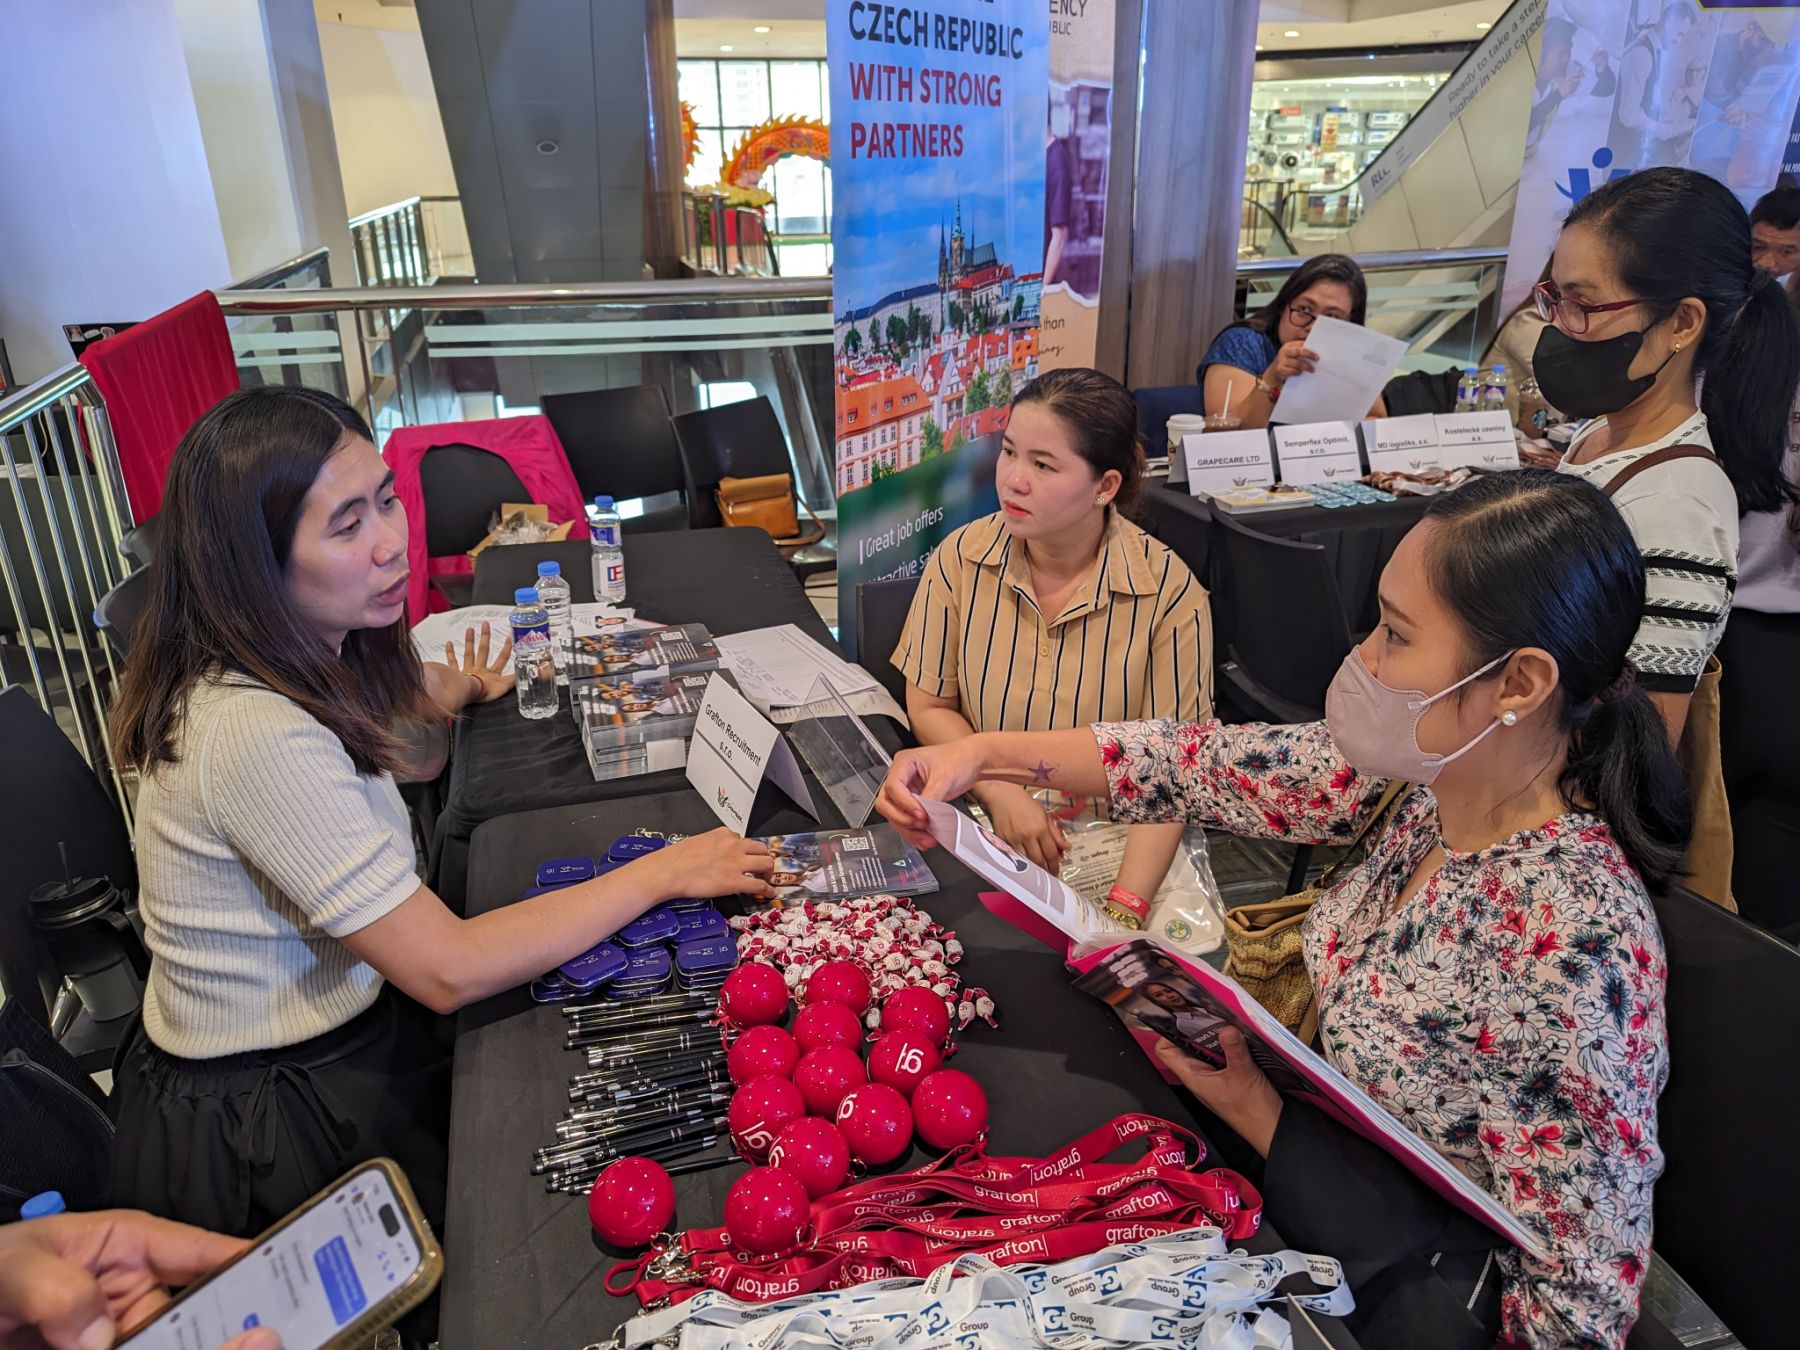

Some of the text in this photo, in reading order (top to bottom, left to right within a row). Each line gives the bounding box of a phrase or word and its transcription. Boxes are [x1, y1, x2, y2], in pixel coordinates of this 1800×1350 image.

[849, 0, 1024, 60] CZECH REPUBLIC
[1480, 74, 1490, 88] in
[1514, 10, 1546, 50] career
[1448, 69, 1476, 103] Ready
[1477, 57, 1488, 71] to
[1488, 31, 1510, 58] take
[1512, 22, 1518, 33] a
[849, 62, 1002, 107] WITH STRONG
[851, 122, 964, 159] PARTNERS
[1284, 439, 1321, 448] Semperflex
[1197, 455, 1261, 467] GRAPECARE LTD
[865, 506, 944, 559] Great job offers
[705, 703, 726, 731] Grafton
[725, 724, 762, 768] Recruitment
[719, 741, 733, 761] s.r.o.
[1034, 1147, 1081, 1182] grafton
[1105, 1190, 1168, 1220] grafton
[1000, 1212, 1062, 1230] grafton
[931, 1227, 996, 1239] grafton
[1105, 1223, 1168, 1246] grafton
[930, 1265, 947, 1295] Group
[1309, 1263, 1335, 1277] Group
[736, 1277, 800, 1299] grafton
[1068, 1282, 1097, 1297] Group
[1151, 1281, 1180, 1298] Group
[960, 1321, 989, 1332] Group
[1070, 1312, 1094, 1326] Group
[899, 1324, 922, 1345] Group
